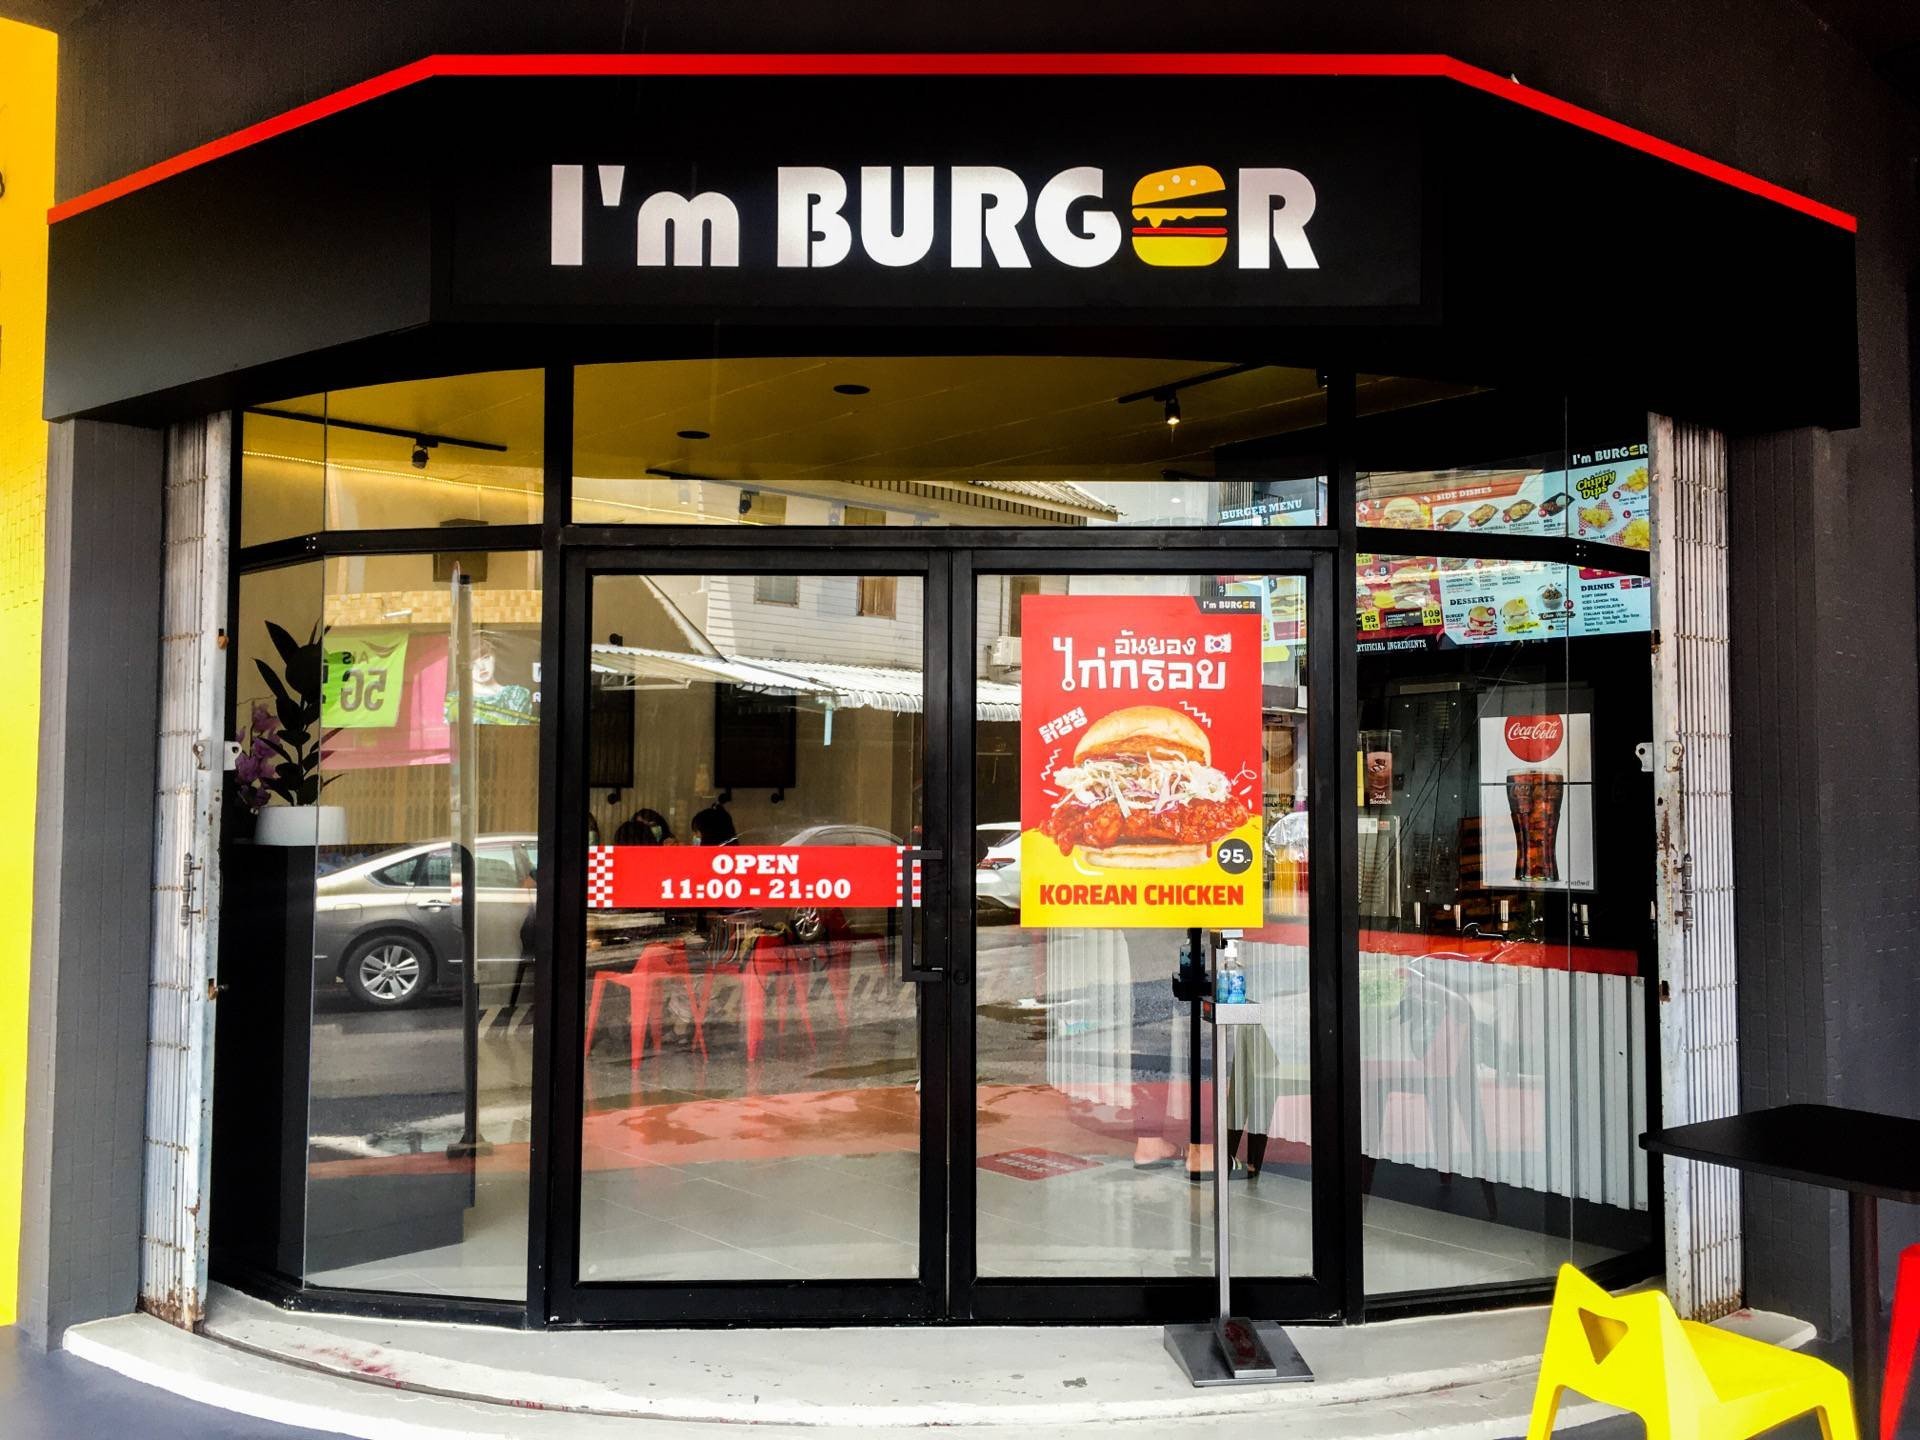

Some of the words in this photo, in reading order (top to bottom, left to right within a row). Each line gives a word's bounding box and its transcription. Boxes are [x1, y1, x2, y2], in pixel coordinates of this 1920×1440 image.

[550, 164, 740, 268] I'm
[1572, 453, 1592, 465] I'm
[1576, 470, 1617, 492] Chippy
[1436, 491, 1458, 501] SIDE
[1458, 487, 1493, 498] DISHES
[1581, 485, 1608, 500] Dips
[1221, 504, 1267, 520] BURGER
[1268, 499, 1303, 513] MENU
[1580, 583, 1615, 592] DRINKS
[1203, 601, 1217, 609] I'm
[1449, 595, 1495, 606] DESSERTS
[1364, 615, 1376, 623] 95
[1423, 610, 1440, 618] 109
[1387, 639, 1427, 651] INGREDIENTS
[1052, 636, 1226, 692] ไก่กรอบ
[1508, 721, 1560, 741] Coca-Cola
[711, 853, 800, 875] OPEN
[660, 878, 743, 900] 11:00
[768, 878, 852, 900] 21:00
[1040, 884, 1138, 906] KOREAN
[1143, 884, 1244, 906] CHICKEN
